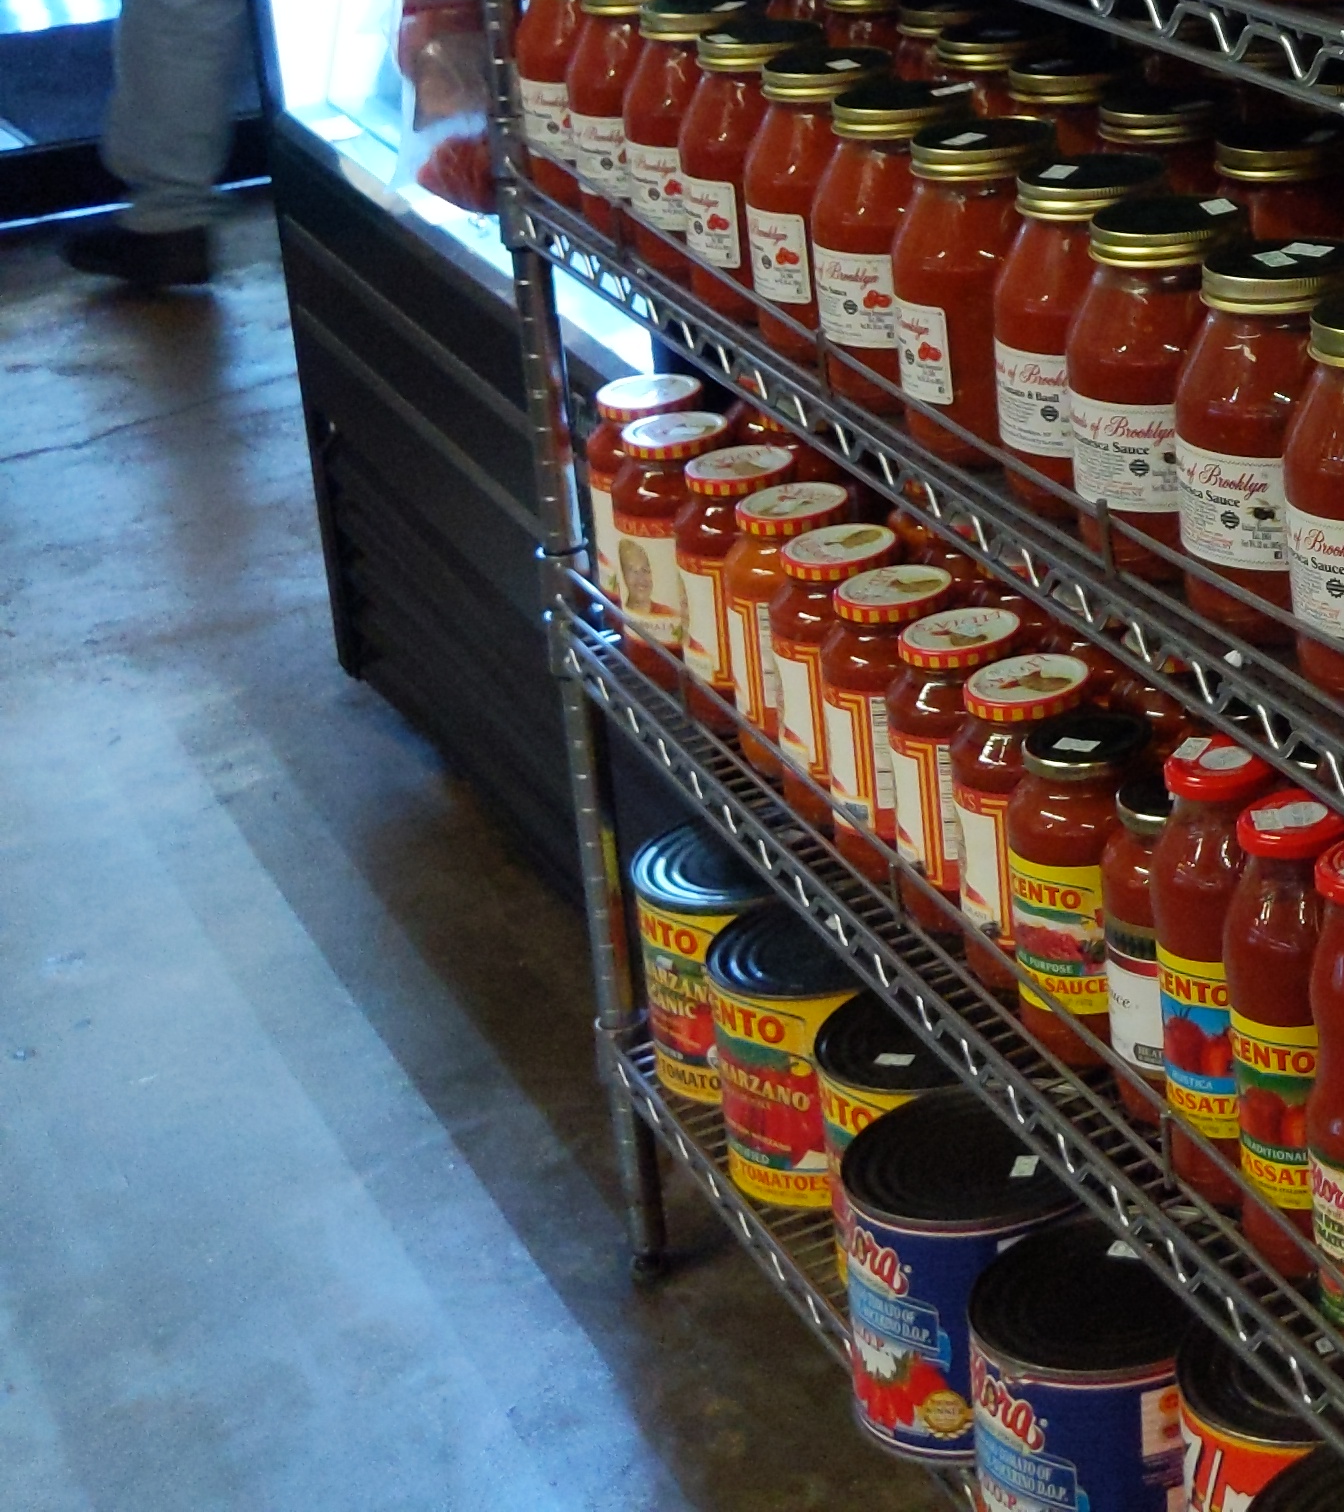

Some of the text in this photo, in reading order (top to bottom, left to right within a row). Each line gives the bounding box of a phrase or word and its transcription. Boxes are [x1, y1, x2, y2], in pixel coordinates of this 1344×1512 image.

[1105, 415, 1175, 448] Brooklyn
[1113, 442, 1150, 455] Sauce
[1199, 464, 1268, 501] Brooklyn
[1205, 493, 1240, 508] Sauce
[1311, 559, 1344, 576] Sauce
[1029, 959, 1072, 973] PURPOSE
[1046, 978, 1107, 994] SAUCE
[1234, 1037, 1314, 1072] CENTO
